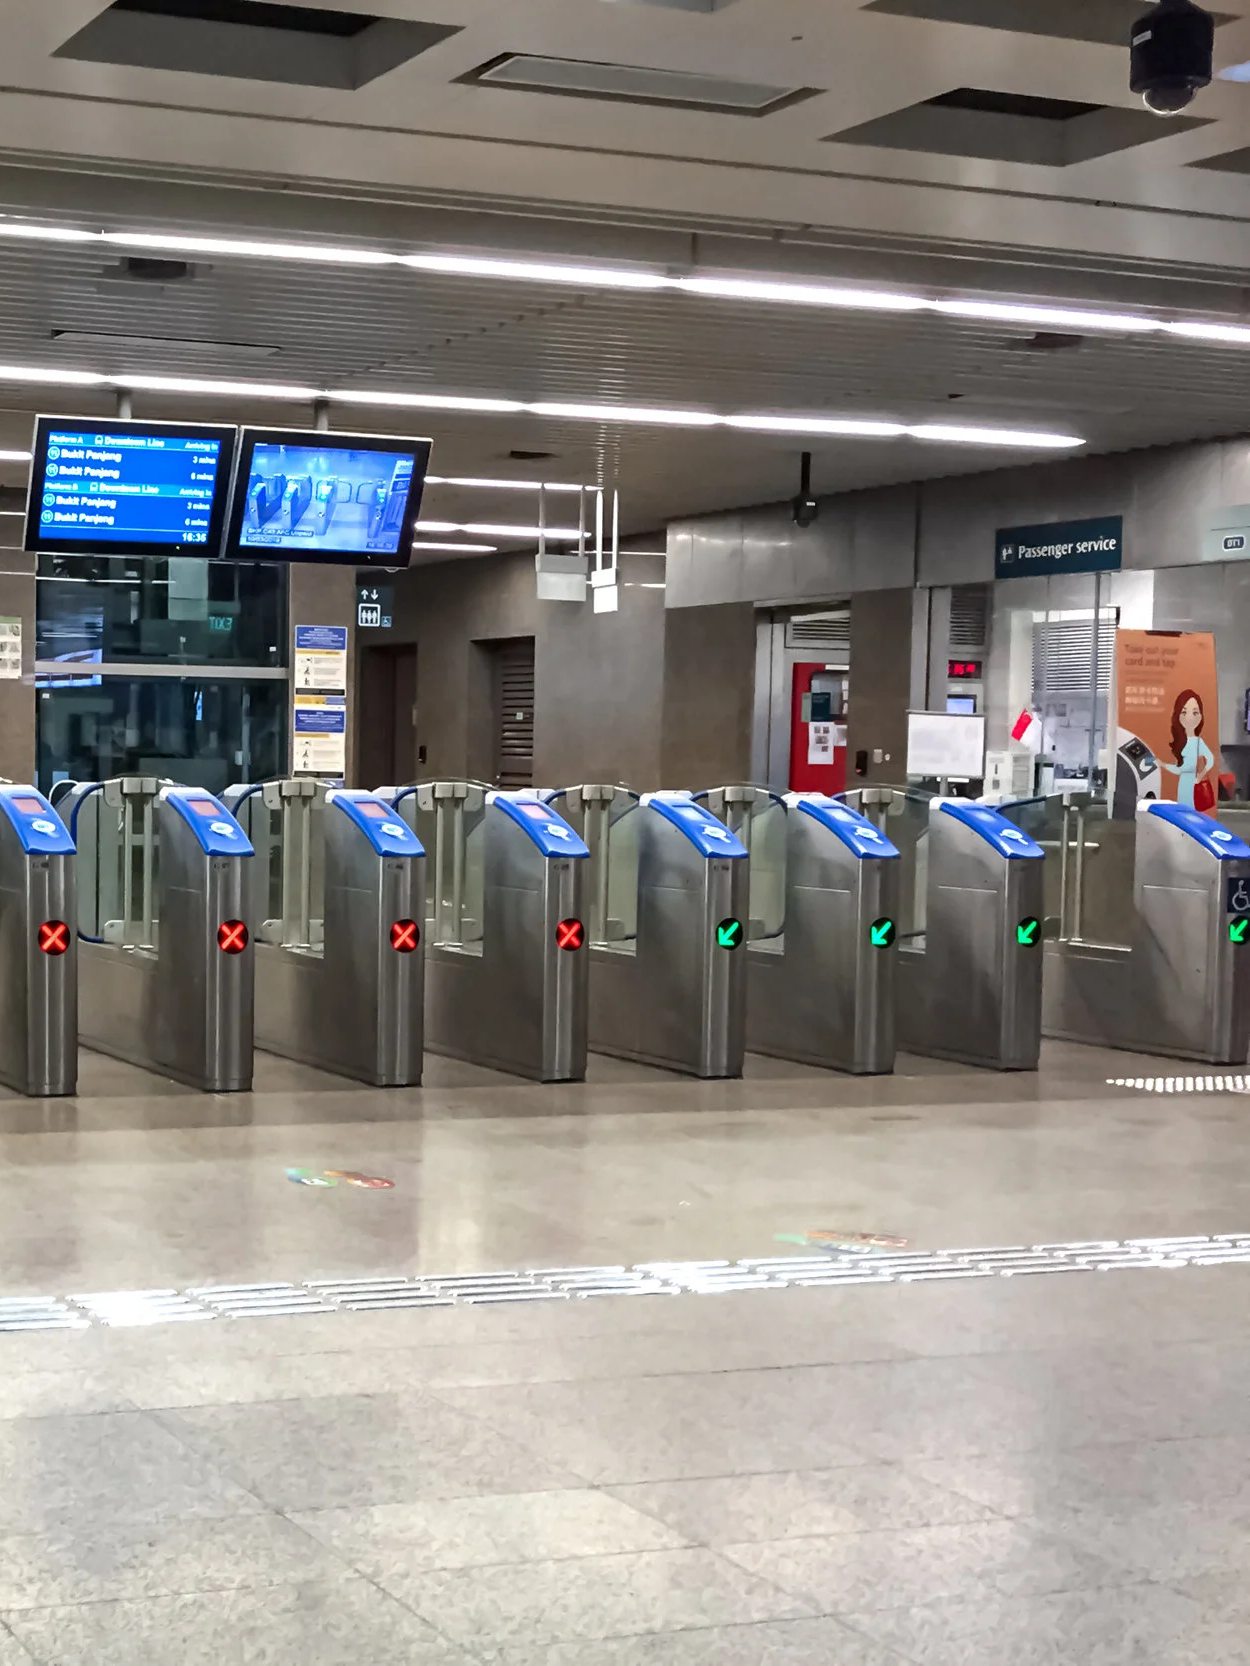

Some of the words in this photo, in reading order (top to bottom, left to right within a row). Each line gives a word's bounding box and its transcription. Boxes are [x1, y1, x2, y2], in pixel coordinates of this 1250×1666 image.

[104, 436, 146, 447] Downtown
[147, 438, 165, 448] Line
[61, 448, 84, 459] Bukit
[85, 449, 122, 463] Panjang
[192, 456, 198, 464] 3
[59, 465, 83, 476] Bukit
[84, 466, 120, 479] Panjang
[100, 482, 140, 493] Downtown
[141, 485, 159, 494] Line
[56, 495, 79, 505] Bukit
[80, 496, 116, 509] Panjang
[187, 502, 192, 510] 3
[54, 512, 78, 522] Bukit
[79, 513, 115, 525] Panjang
[1018, 542, 1073, 560] Passenger
[1075, 536, 1117, 553] service
